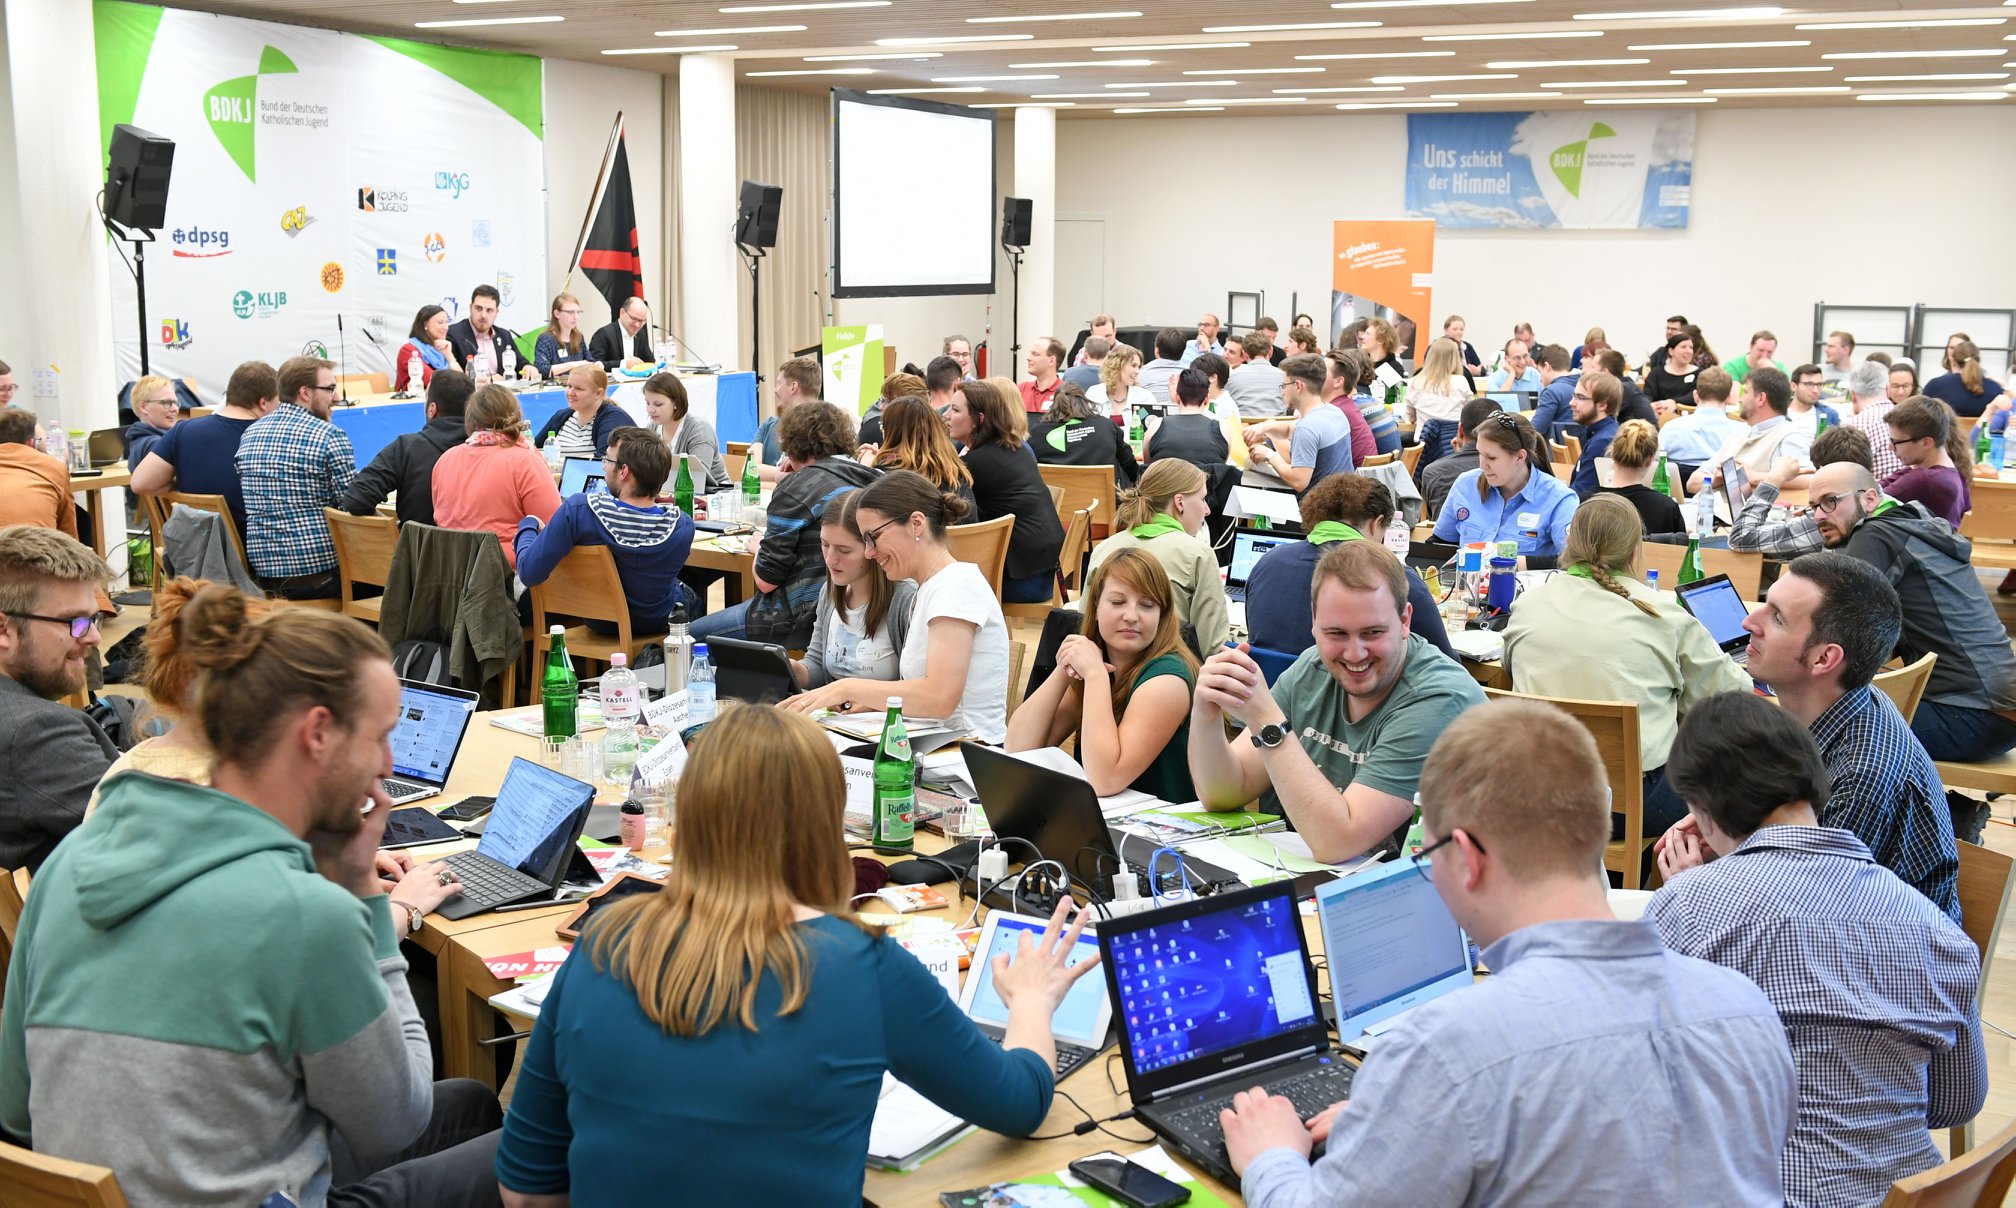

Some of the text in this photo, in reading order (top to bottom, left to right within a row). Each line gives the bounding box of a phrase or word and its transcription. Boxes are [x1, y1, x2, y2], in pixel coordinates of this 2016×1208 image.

[210, 95, 250, 123] BDKJ
[260, 99, 328, 114] Bund der Deutschen
[261, 113, 329, 129] Katholischen Jugend
[1423, 143, 1503, 168] Uns schickt
[1553, 152, 1581, 168] BDKJ
[1428, 171, 1511, 194] der Himmel
[377, 202, 409, 212] JUGEND
[281, 206, 306, 231] CAJ
[188, 226, 229, 247] dpsg
[258, 291, 288, 309] KLJB
[673, 712, 688, 723] Aache
